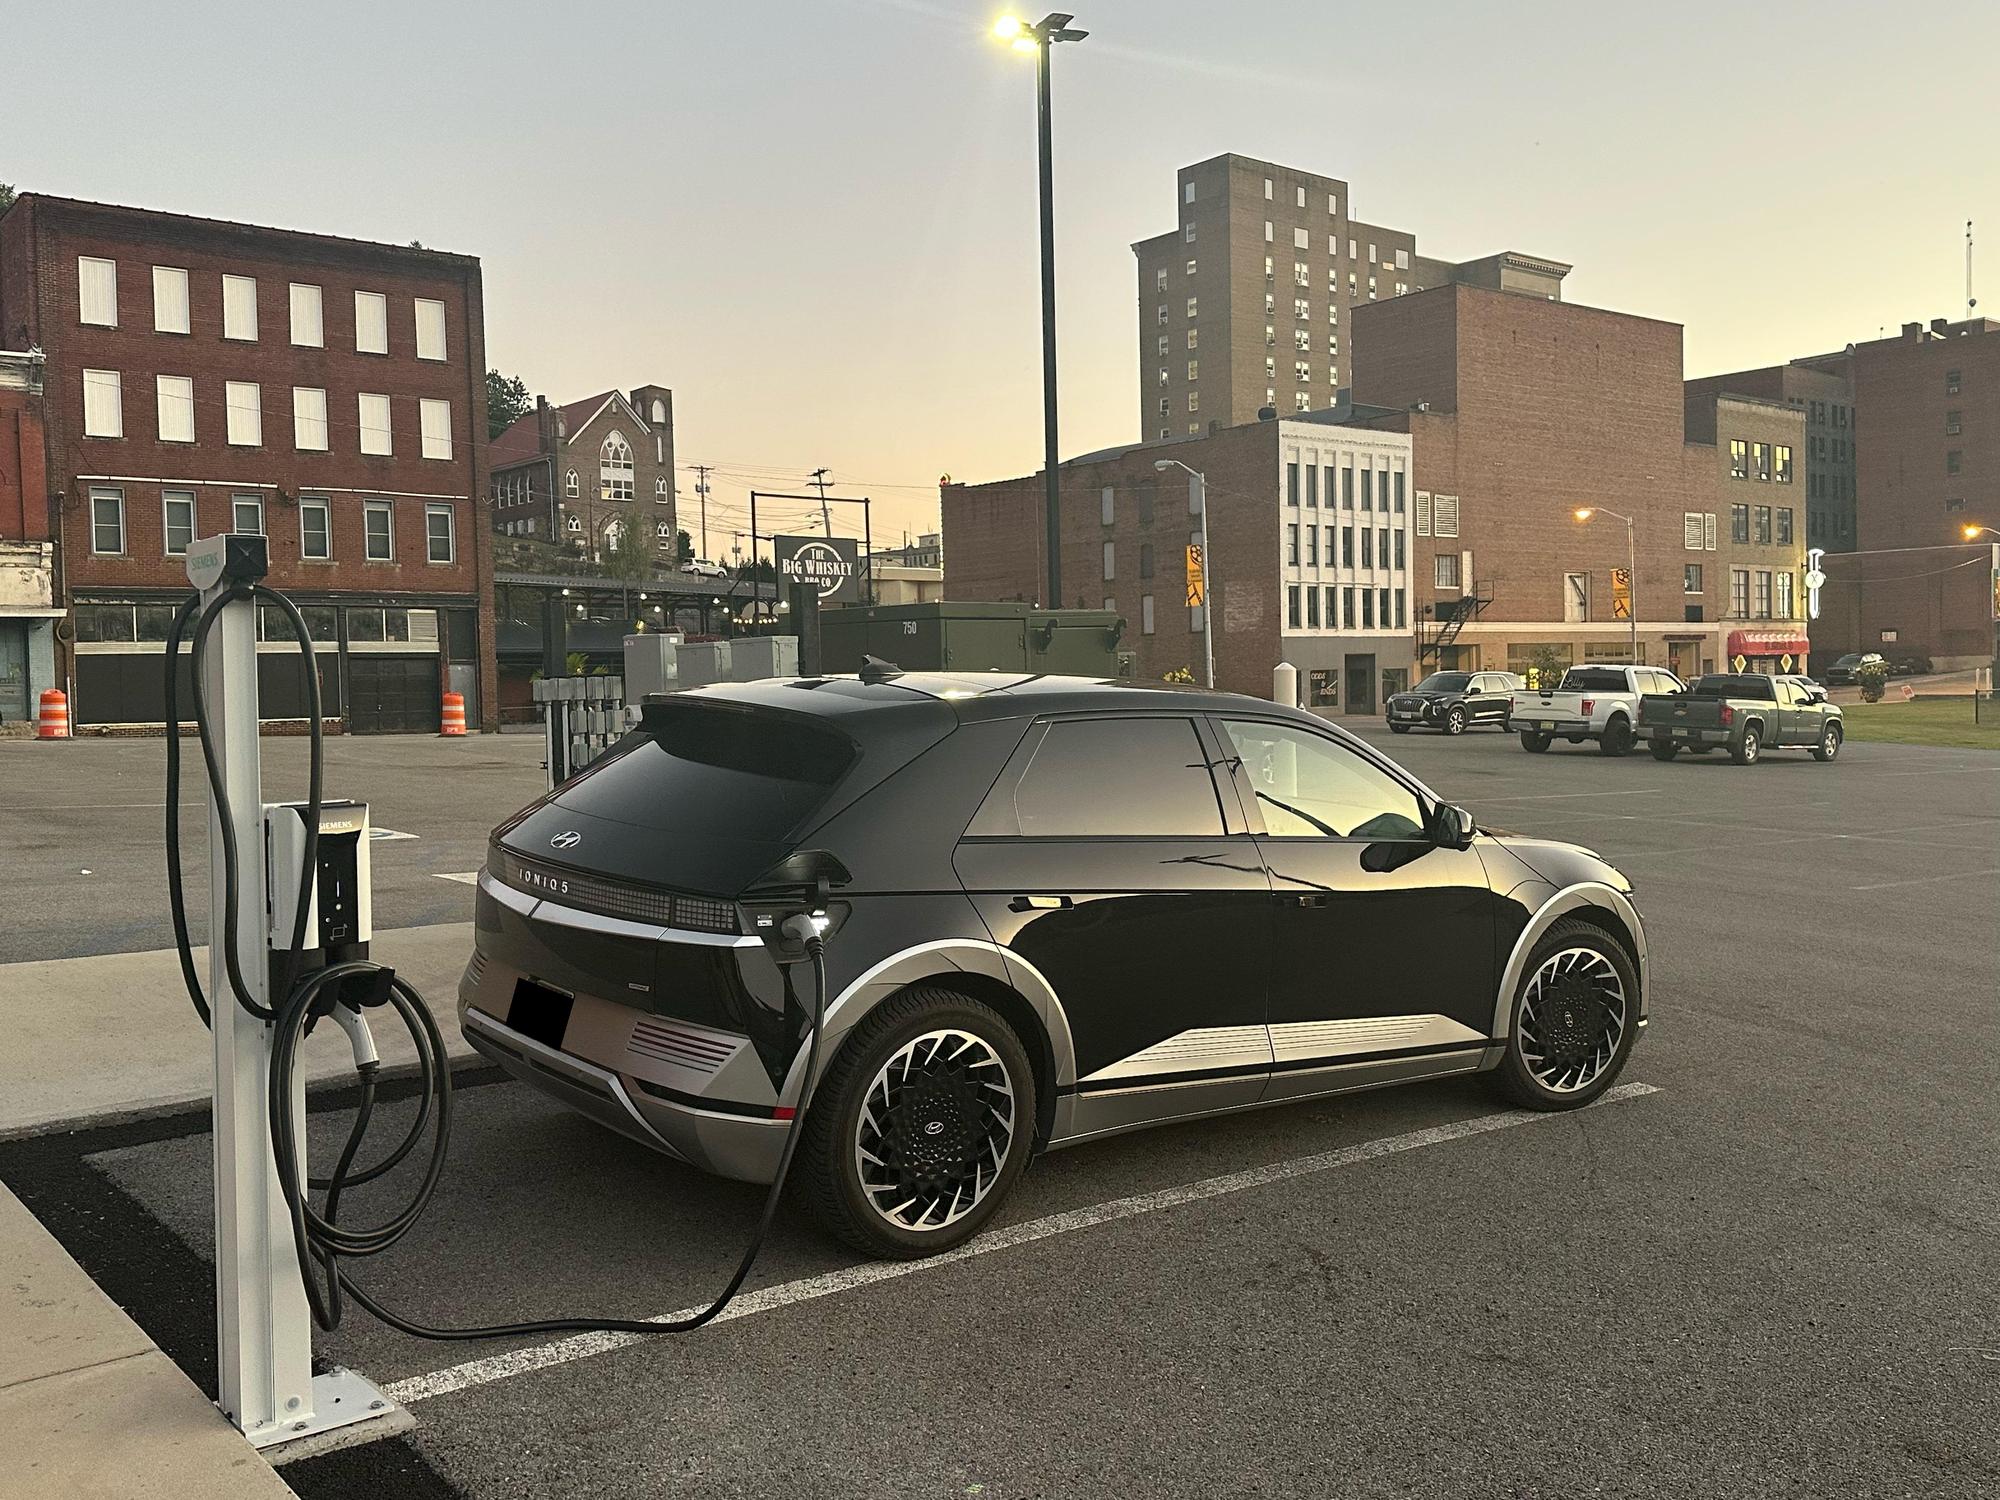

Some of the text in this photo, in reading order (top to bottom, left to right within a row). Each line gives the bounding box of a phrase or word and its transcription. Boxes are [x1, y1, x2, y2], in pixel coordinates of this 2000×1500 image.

[810, 548, 825, 560] THE
[782, 558, 853, 576] BIG WHISKEY
[902, 621, 917, 635] 750
[319, 820, 353, 830] SIEMENS
[519, 868, 568, 894] IONIQ 5
